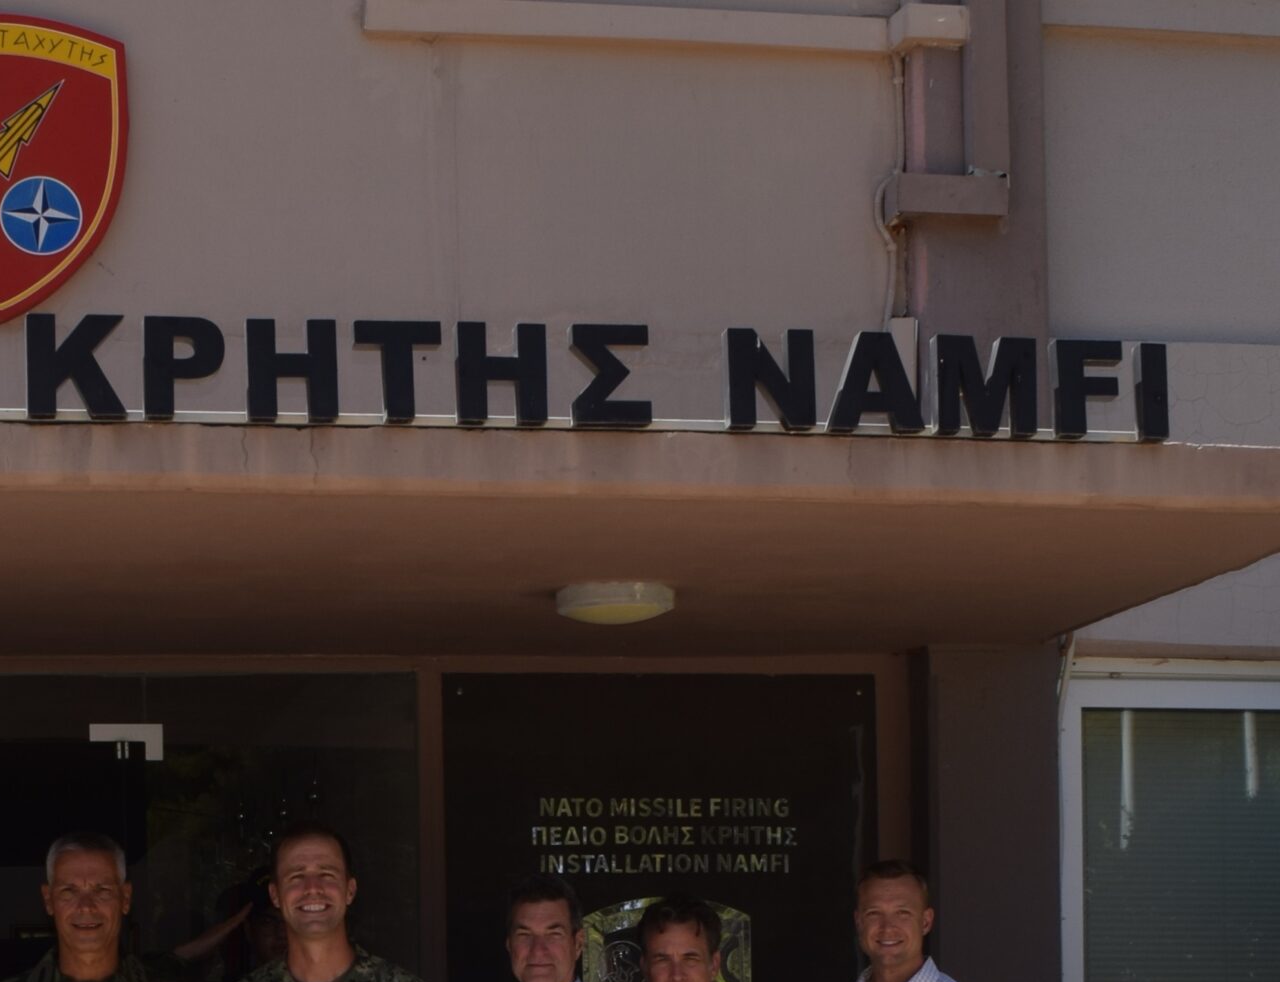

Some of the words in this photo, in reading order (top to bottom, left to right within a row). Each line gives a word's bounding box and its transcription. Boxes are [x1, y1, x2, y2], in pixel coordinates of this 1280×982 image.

[25, 313, 653, 427] ΚΡΗΤΗΣ
[724, 328, 1170, 441] NAMFI
[538, 797, 604, 818] NATO
[609, 797, 703, 818] MISSILE
[709, 797, 791, 818] FIRING
[531, 825, 607, 846] ΠΕΔΙΟ
[614, 825, 695, 846] ΒΟΛΗΣ
[700, 825, 798, 846] ΚΡΗΤΗΣ
[539, 853, 709, 874] INSTALLATION
[716, 853, 791, 874] NAMFI
